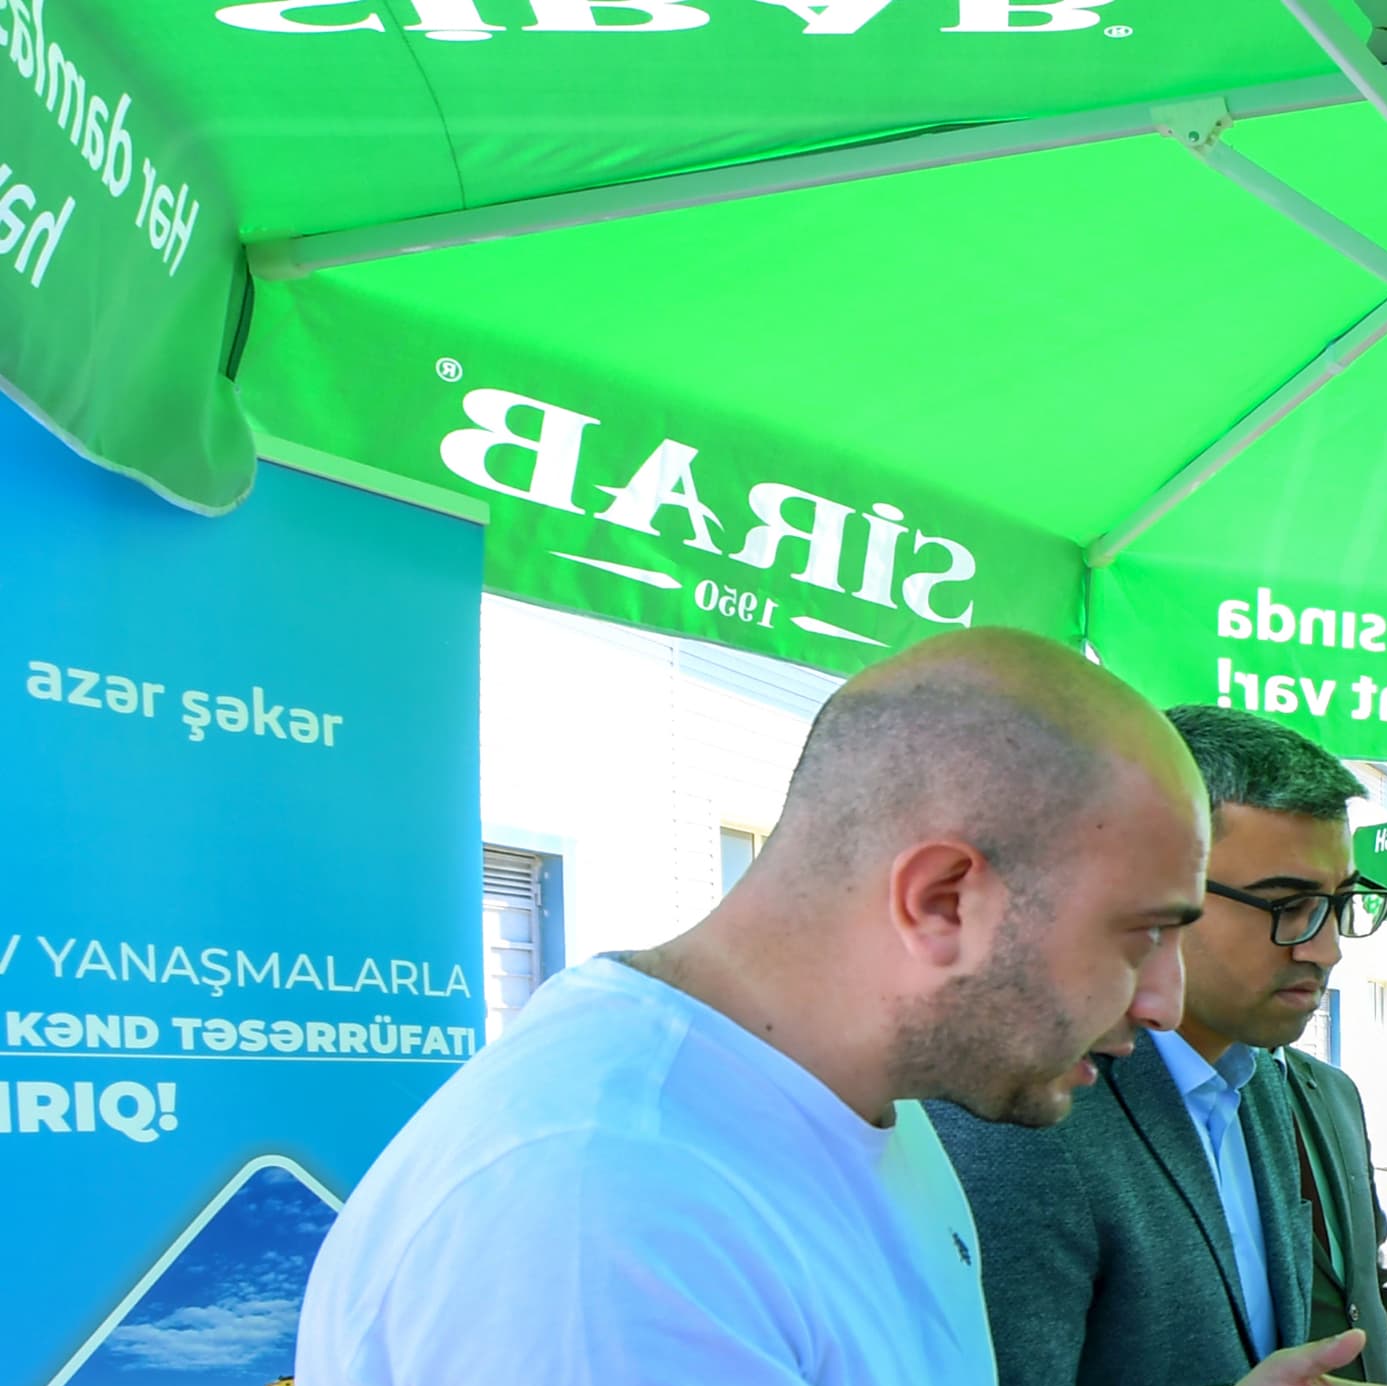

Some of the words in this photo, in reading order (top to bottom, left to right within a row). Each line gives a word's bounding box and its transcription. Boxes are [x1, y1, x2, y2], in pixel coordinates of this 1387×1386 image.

[26, 659, 164, 719] azər
[181, 687, 344, 747] şəkər
[37, 936, 470, 999] YANAŞMALARLA
[6, 1010, 160, 1050] KƏND
[171, 1016, 477, 1057] TƏSƏRRÜFATI
